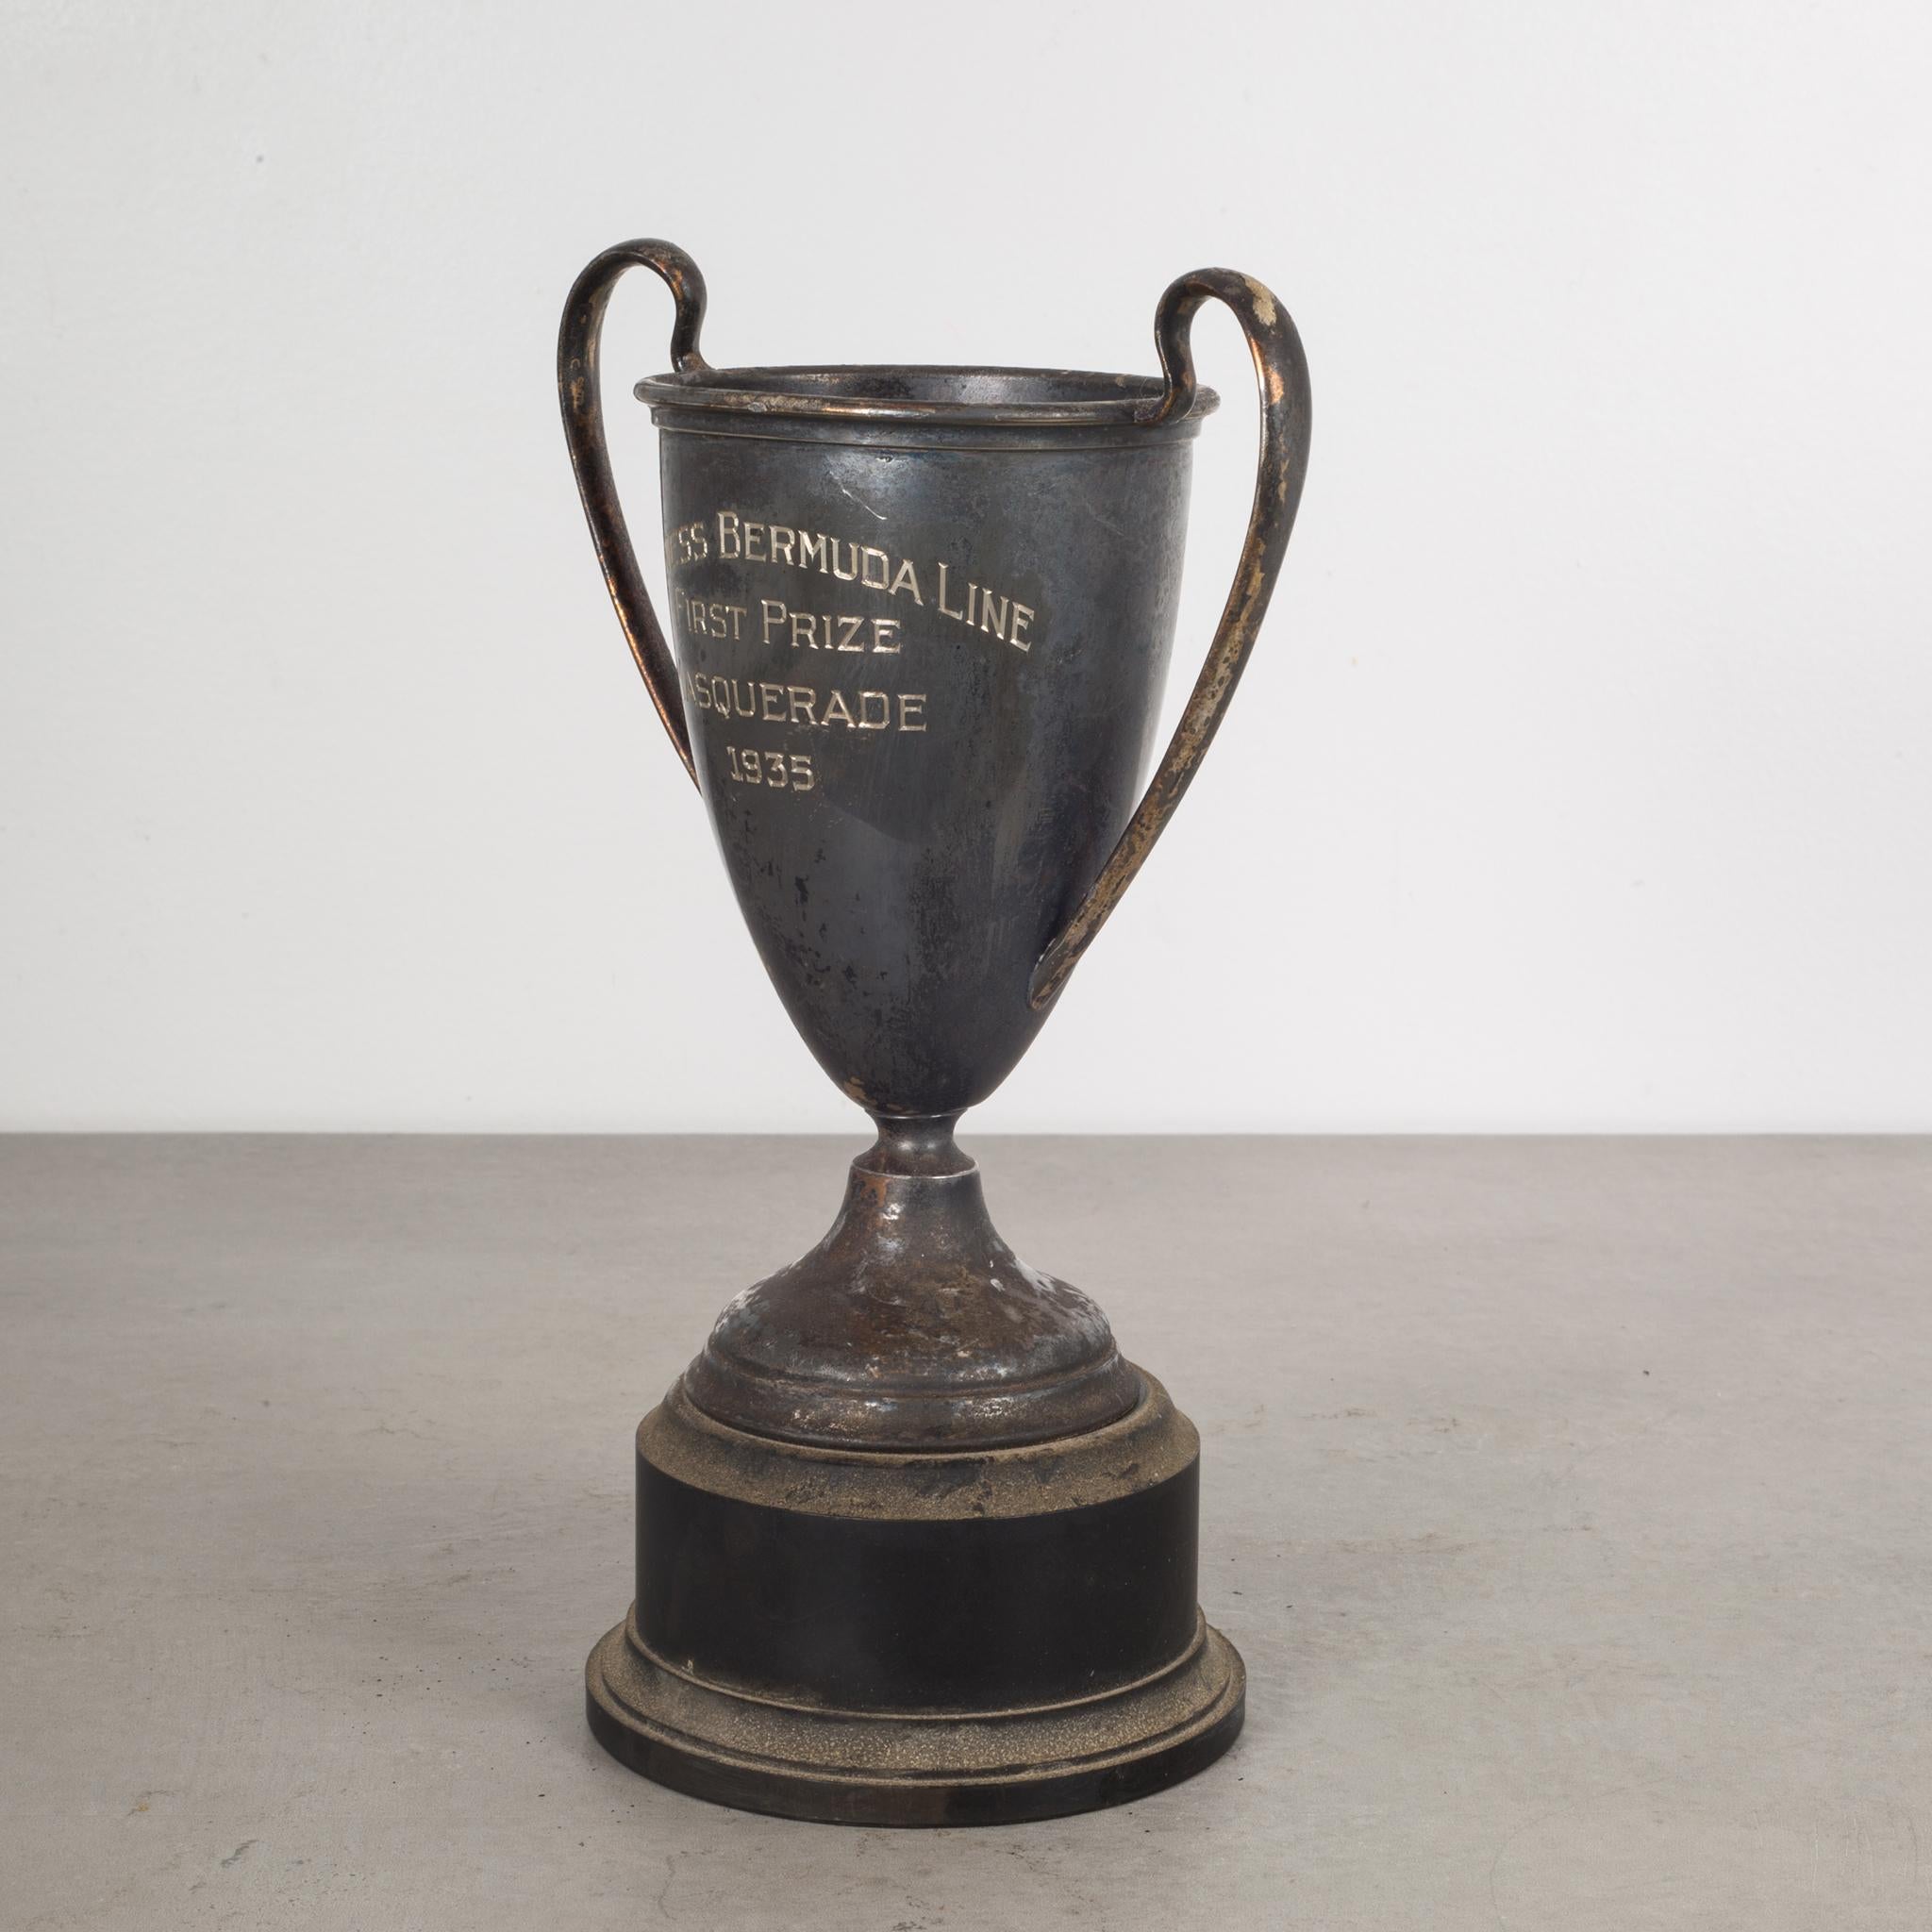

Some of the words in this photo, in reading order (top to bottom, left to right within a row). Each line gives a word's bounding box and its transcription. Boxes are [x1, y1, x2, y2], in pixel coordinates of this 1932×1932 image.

[664, 521, 708, 565] ESS
[716, 509, 924, 607] BERMUDA
[938, 561, 1036, 654] LINE
[675, 587, 748, 641] FIRST
[760, 599, 902, 655] PRIZE
[681, 671, 927, 733] ASQUERADE
[726, 746, 817, 792] 1935
